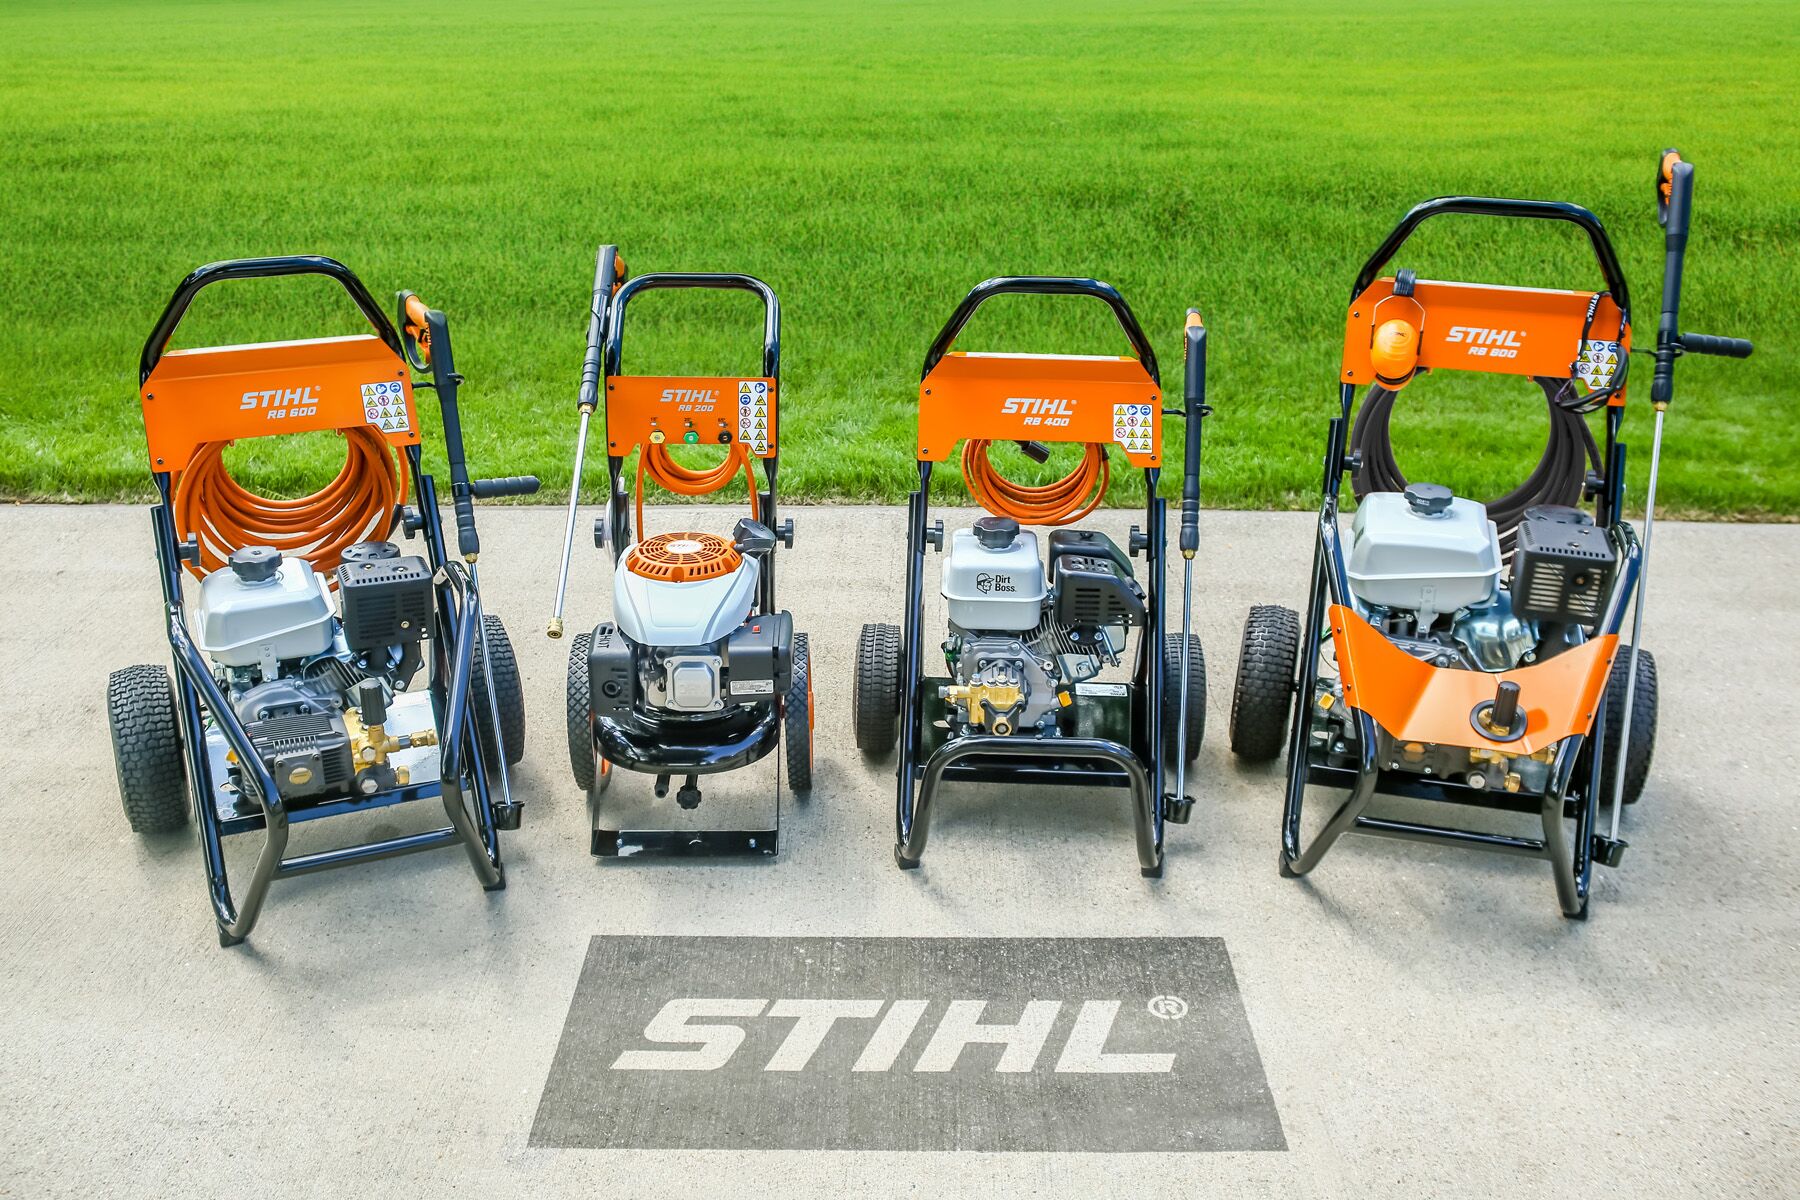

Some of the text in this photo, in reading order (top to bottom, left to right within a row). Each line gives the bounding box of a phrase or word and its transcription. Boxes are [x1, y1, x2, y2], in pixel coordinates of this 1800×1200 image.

[1468, 346, 1518, 358] RB 800
[267, 406, 317, 419] RB 600
[1024, 417, 1070, 427] RB 400
[995, 575, 1010, 583] Dirt
